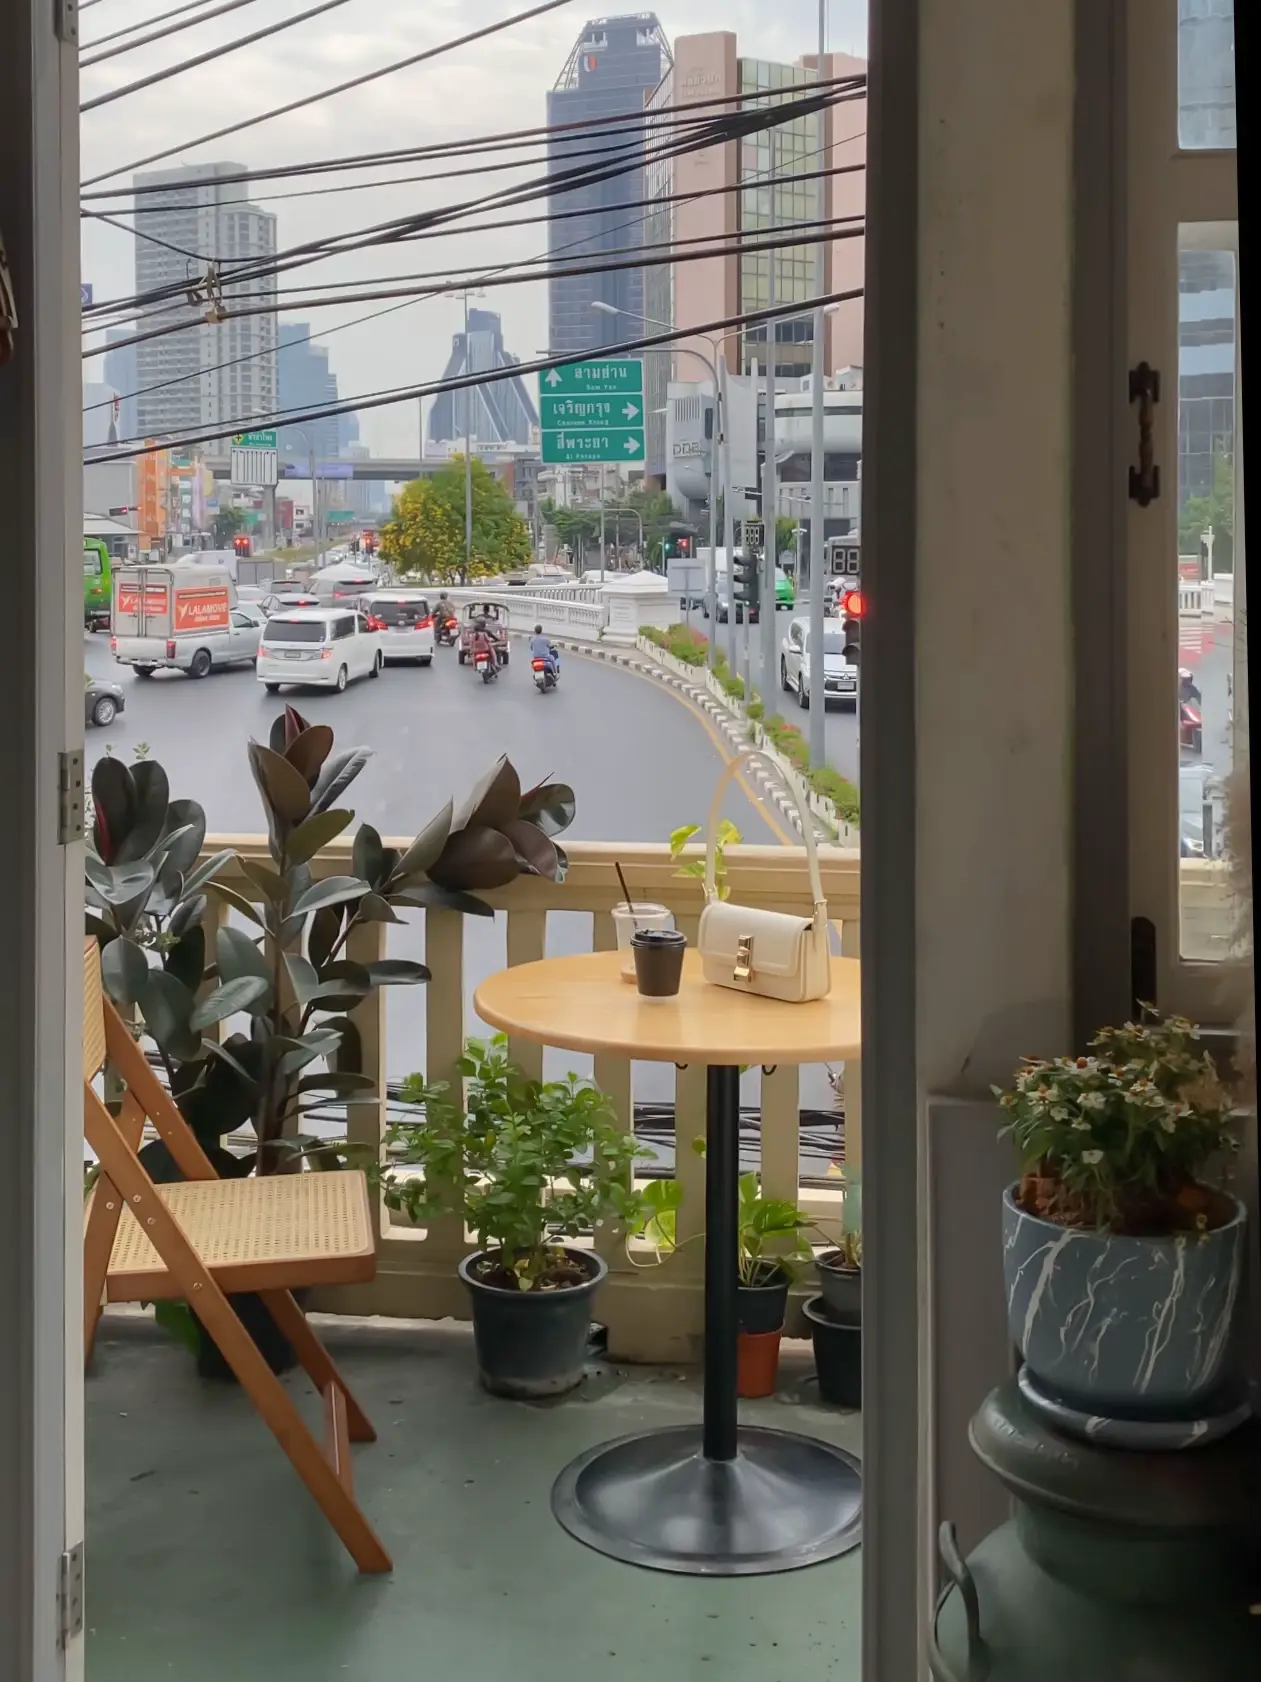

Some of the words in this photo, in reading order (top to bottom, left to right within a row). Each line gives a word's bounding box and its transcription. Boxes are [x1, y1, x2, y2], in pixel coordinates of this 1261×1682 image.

[574, 364, 627, 379] สามย่าน
[553, 399, 611, 418] เจริญกรุง
[557, 431, 609, 450] สี่พระยา
